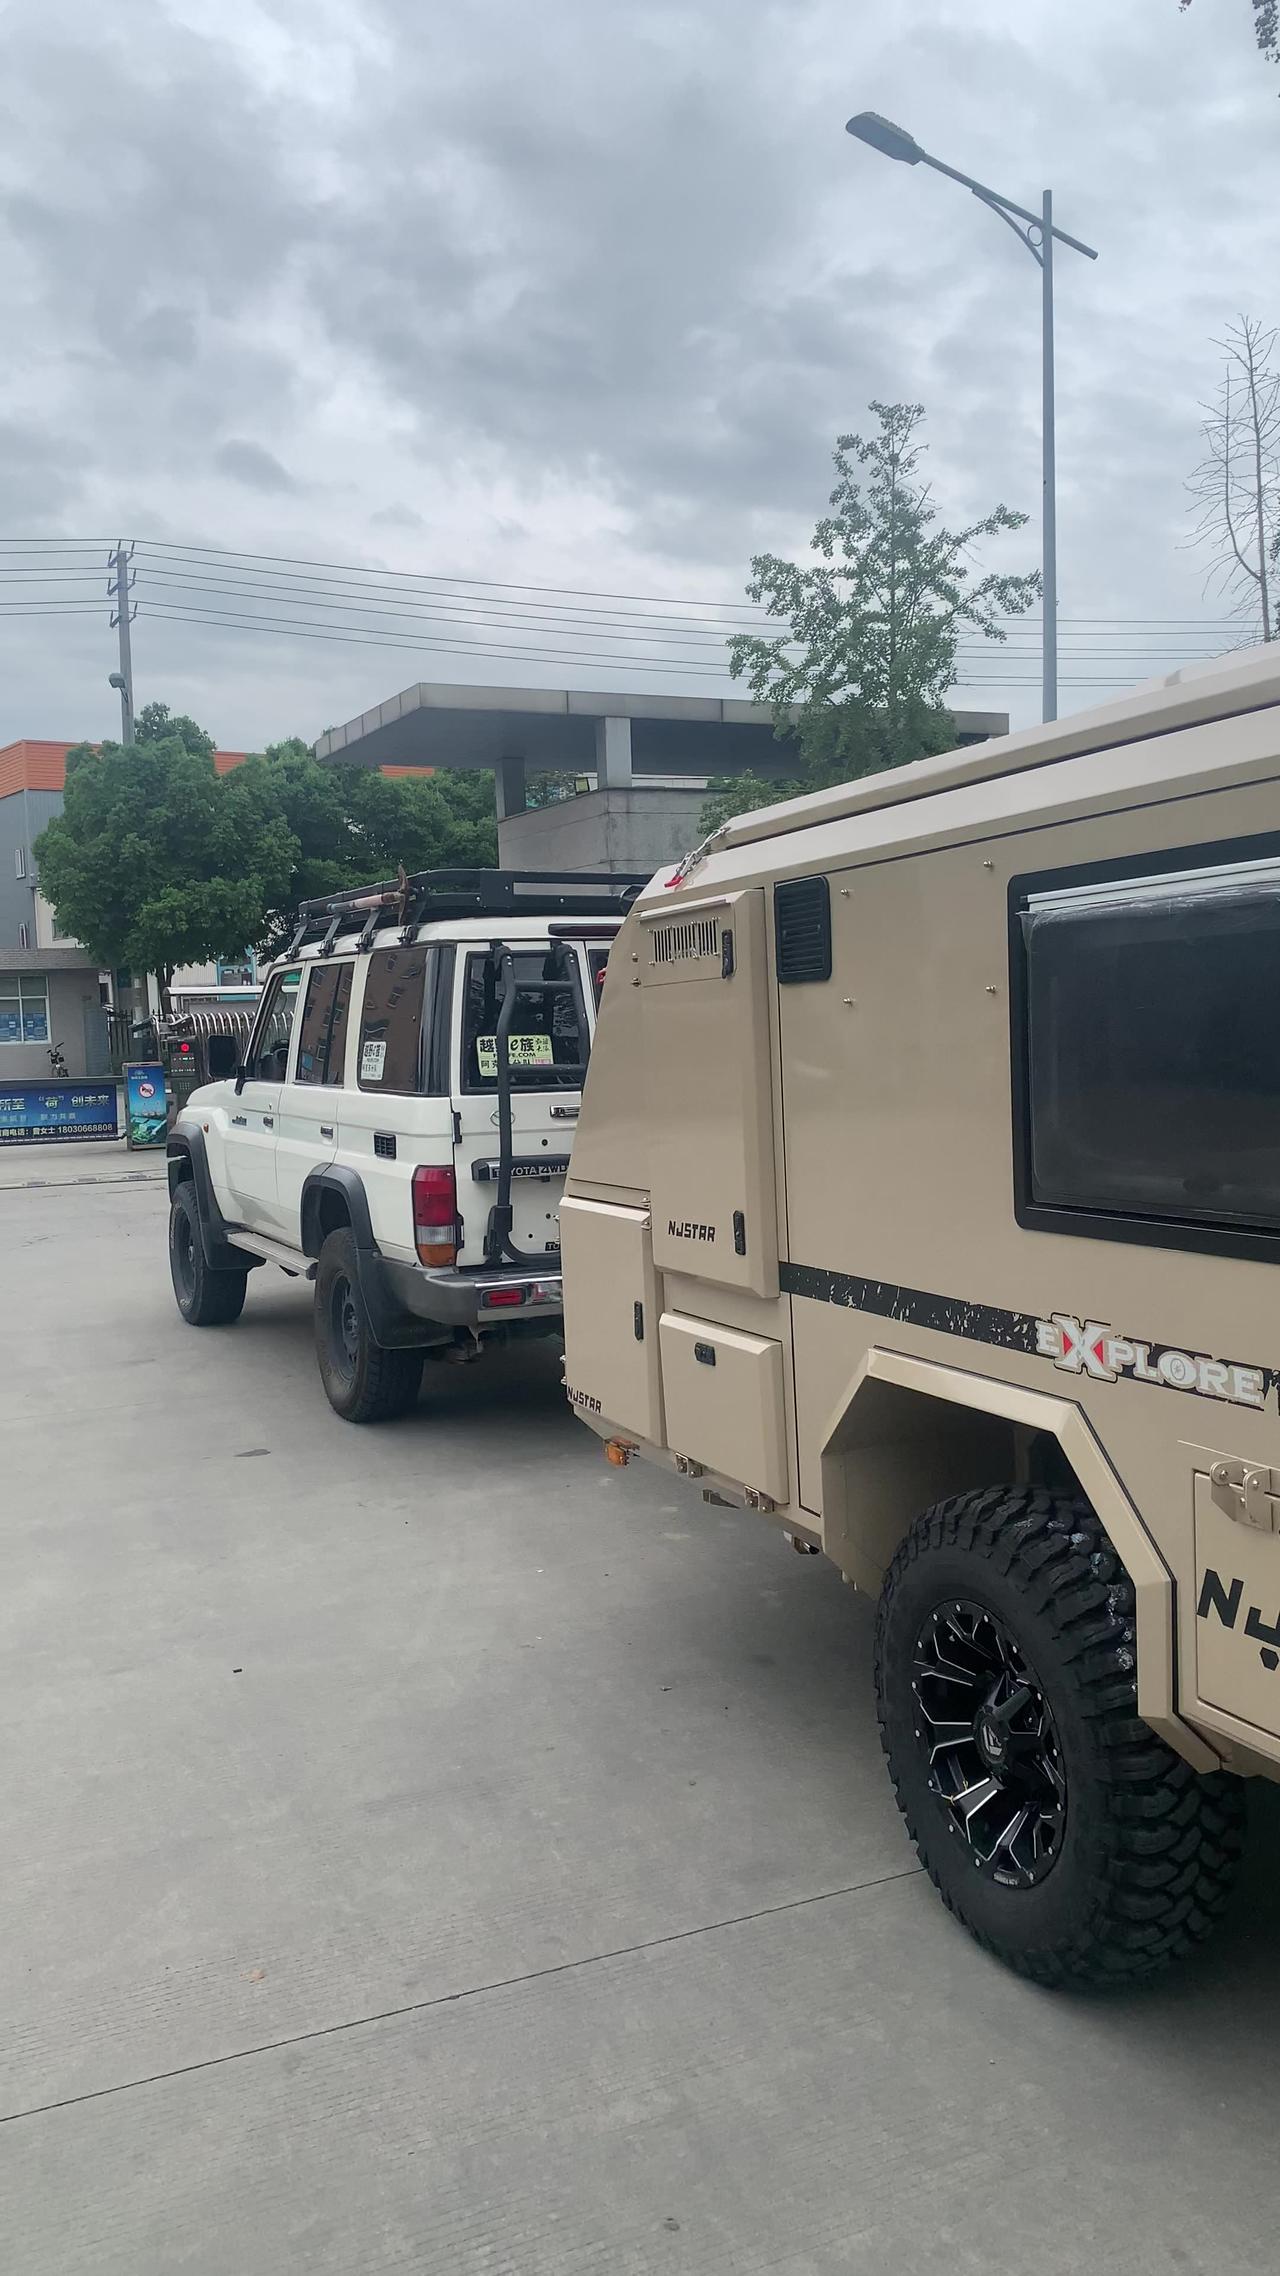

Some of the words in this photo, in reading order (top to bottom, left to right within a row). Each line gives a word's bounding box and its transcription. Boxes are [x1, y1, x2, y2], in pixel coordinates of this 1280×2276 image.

[480, 1038, 534, 1052] 越e族
[494, 1166, 537, 1177] TYOTA
[668, 1220, 716, 1242] NJSTAR
[567, 1386, 602, 1413] NJSTAR
